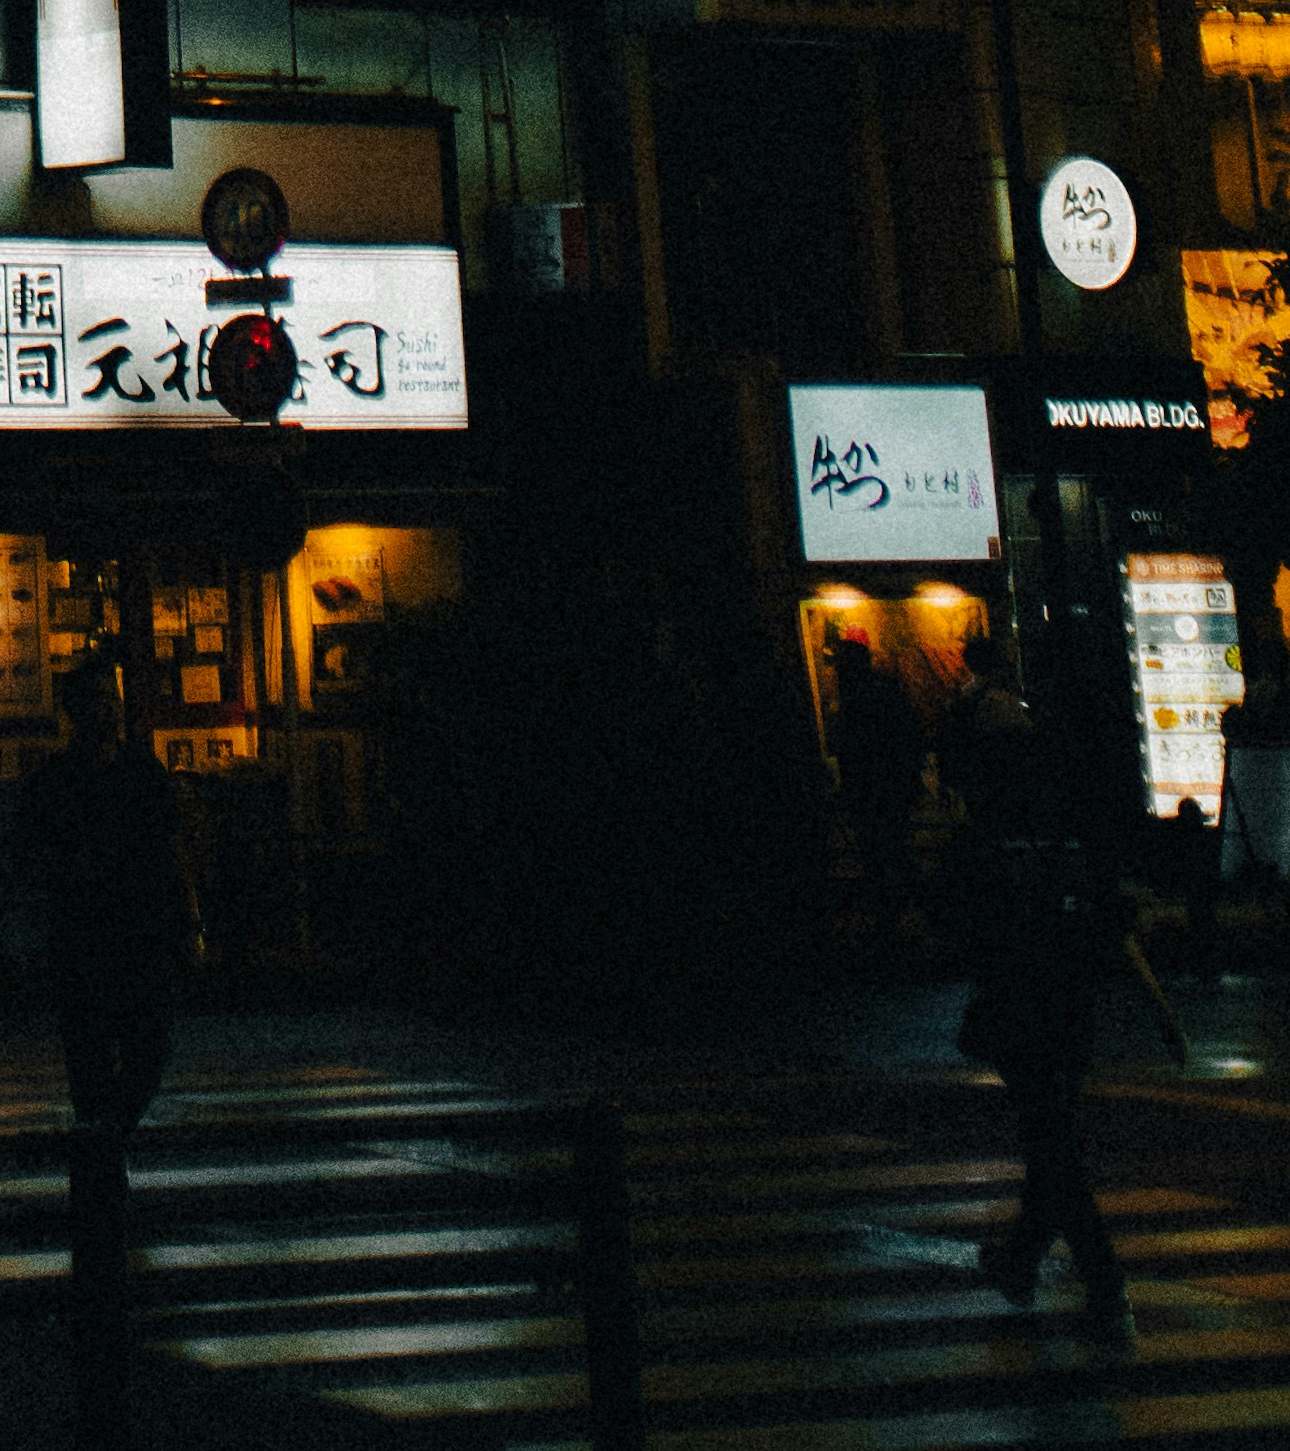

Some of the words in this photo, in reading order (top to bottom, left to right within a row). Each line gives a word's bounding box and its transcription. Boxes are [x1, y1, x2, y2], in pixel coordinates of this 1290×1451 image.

[396, 331, 439, 355] Sushi
[78, 316, 389, 402] 元祖司
[1144, 401, 1205, 430] BLDG.
